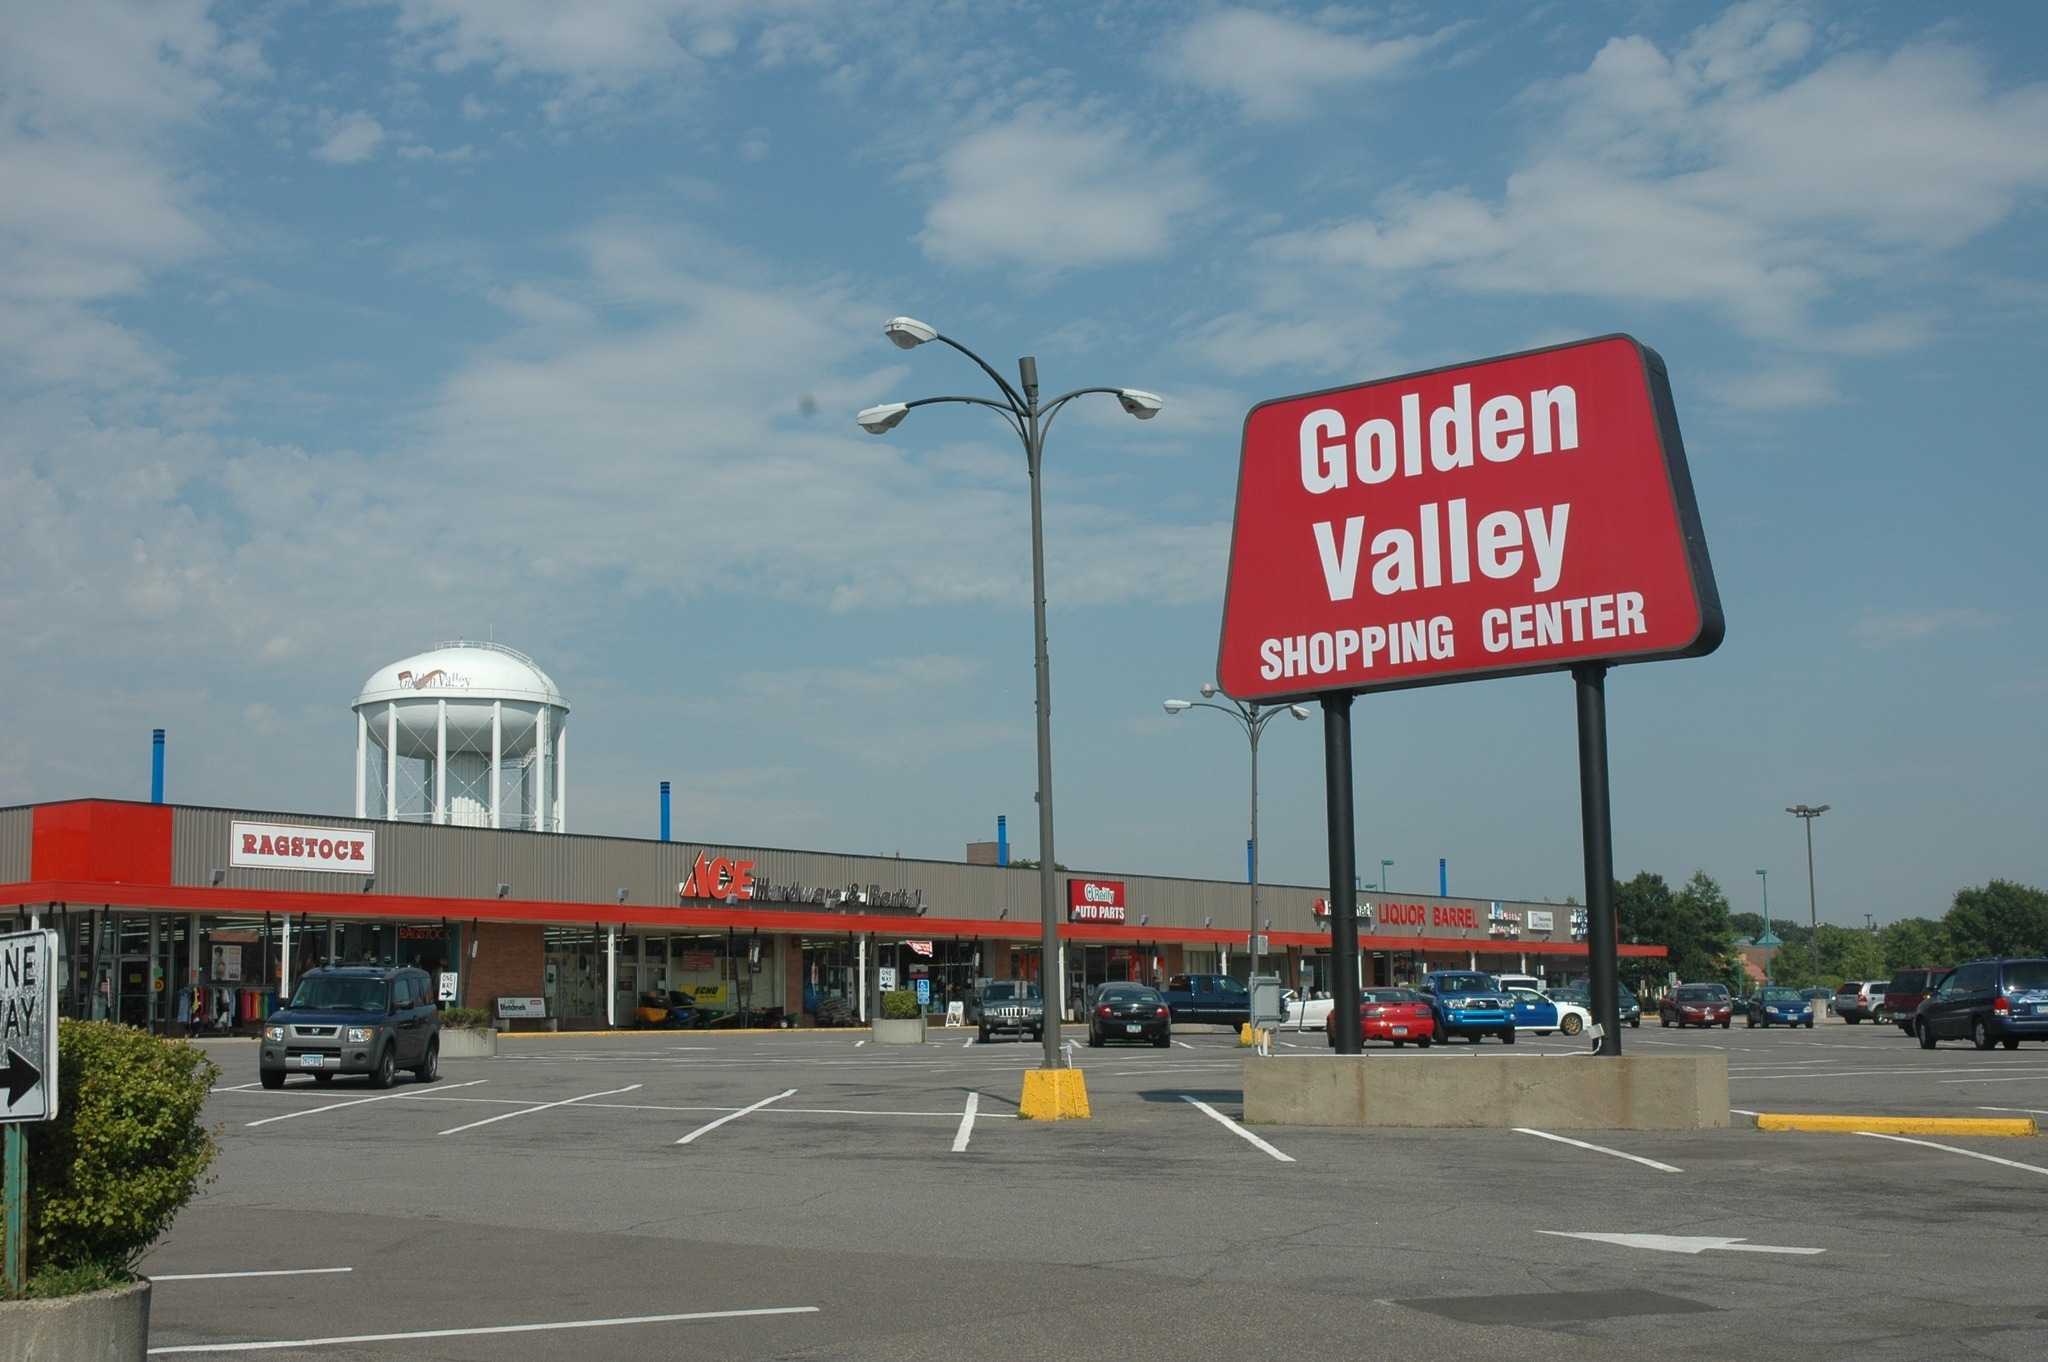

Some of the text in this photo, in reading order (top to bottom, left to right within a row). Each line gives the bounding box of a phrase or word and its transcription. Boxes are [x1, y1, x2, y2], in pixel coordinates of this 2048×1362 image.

[1299, 382, 1579, 495] Golden
[1312, 498, 1571, 602] Valley
[1260, 591, 1648, 681] SHOPPING CENTER
[438, 671, 471, 692] Valley
[242, 834, 365, 861] RAGSTOCK
[680, 849, 922, 908] ACE Hardware & Rental
[1084, 883, 1115, 904] O'Reilly
[1075, 905, 1125, 920] AUTO PARTS
[1378, 902, 1427, 926] LIQUOR
[1432, 906, 1480, 929] BARREL
[399, 927, 452, 940] RAGSTOCK
[0, 945, 36, 989] NE
[442, 974, 453, 982] ONE
[694, 986, 719, 995] ECHO
[0, 996, 36, 1039] AY
